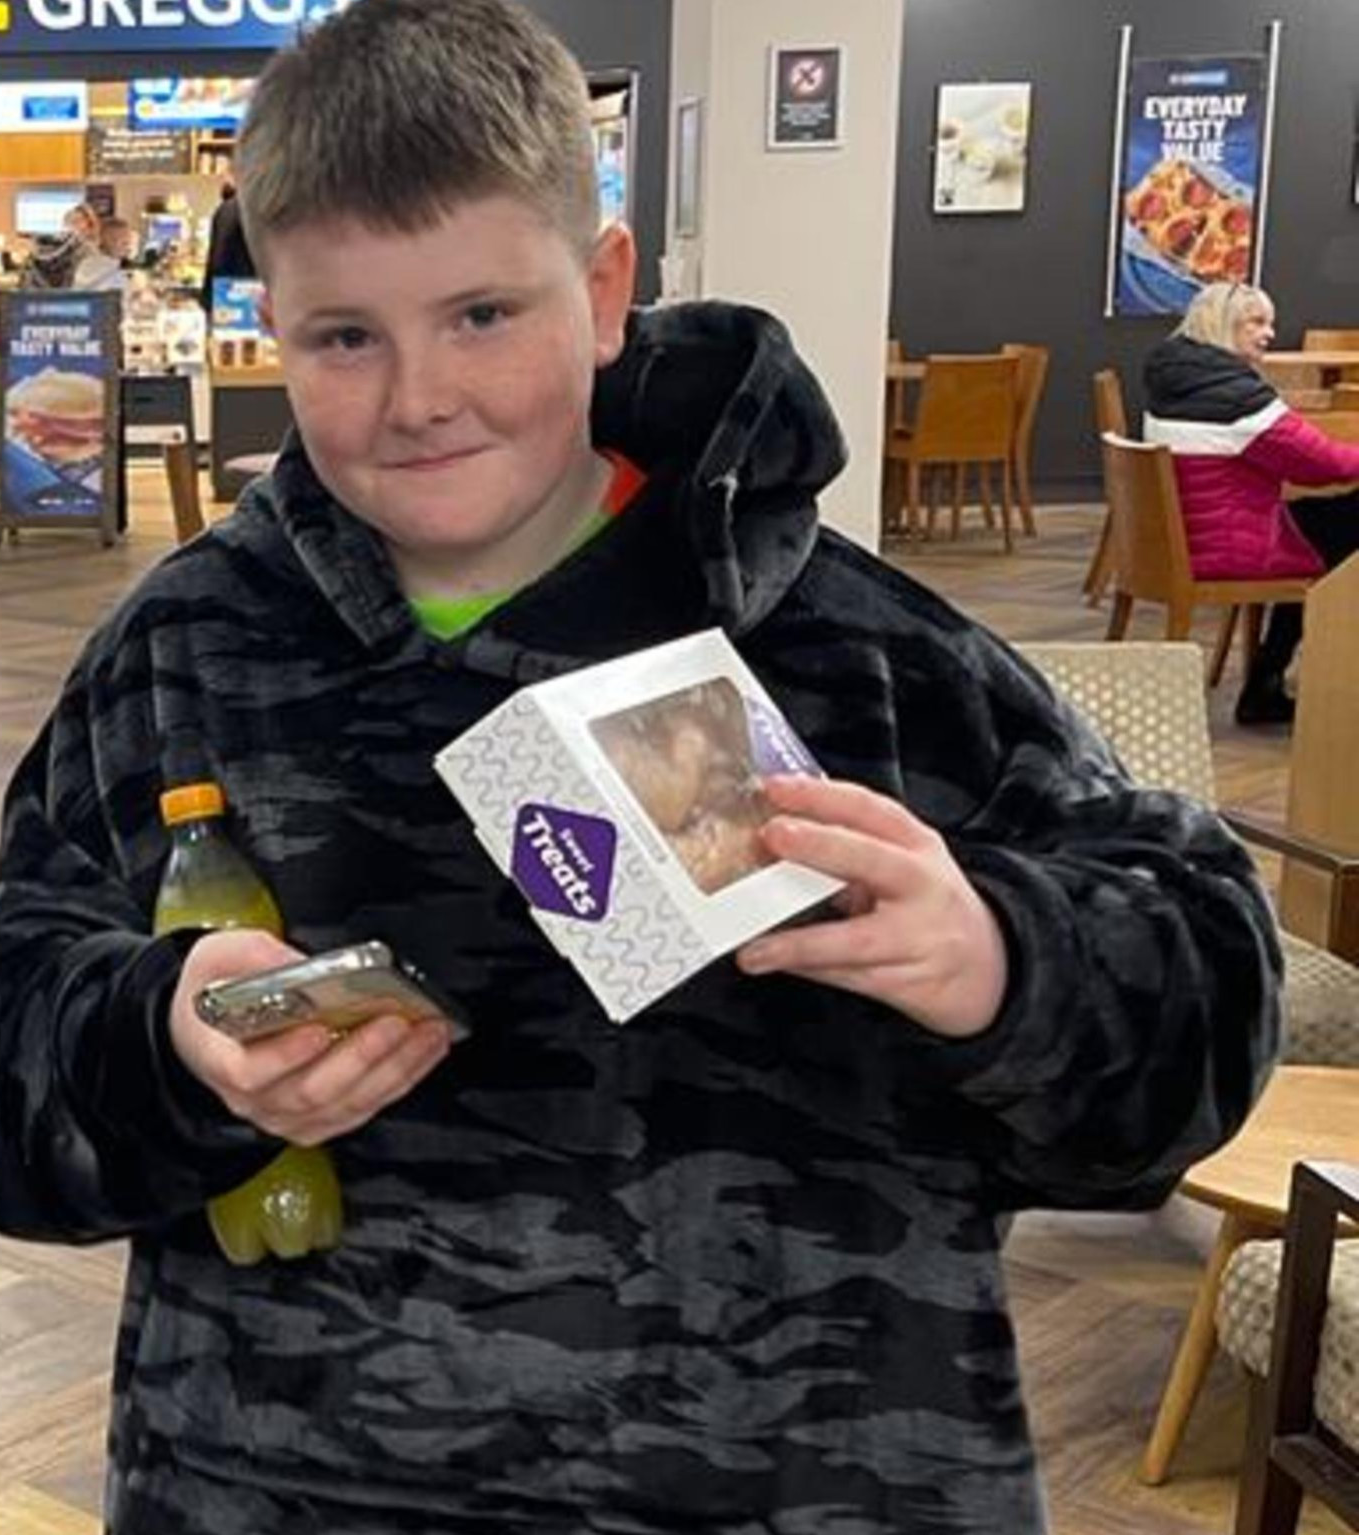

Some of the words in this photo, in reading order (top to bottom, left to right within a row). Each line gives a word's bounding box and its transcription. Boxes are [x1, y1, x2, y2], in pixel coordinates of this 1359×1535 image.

[28, 0, 349, 30] GREGG
[1144, 94, 1247, 119] EVERYDAY
[1162, 119, 1227, 141] TASTY
[1160, 141, 1225, 162] VALUE
[522, 811, 597, 915] Treats
